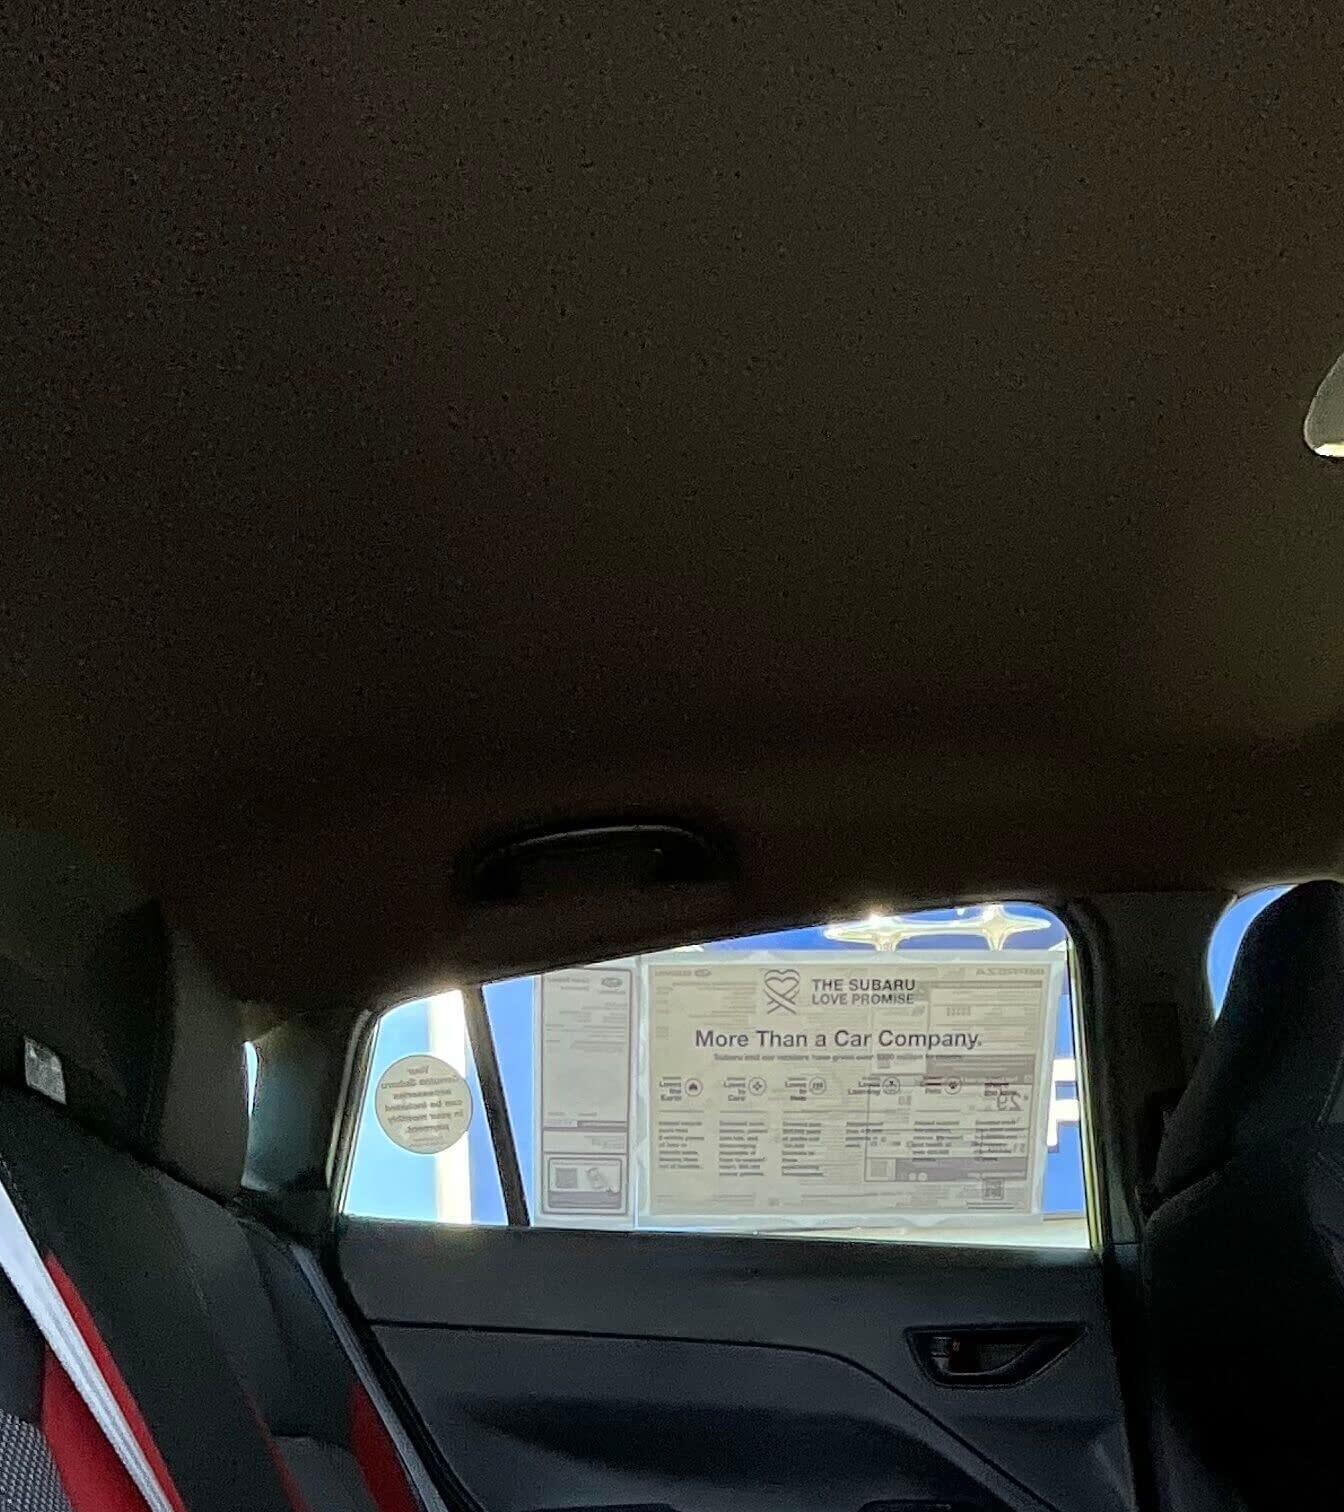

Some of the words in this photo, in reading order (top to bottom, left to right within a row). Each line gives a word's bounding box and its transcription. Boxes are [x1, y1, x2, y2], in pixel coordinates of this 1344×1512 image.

[811, 978, 844, 992] THE
[849, 978, 916, 992] SUBARU
[811, 993, 848, 1005] LOVE
[851, 993, 915, 1005] PROMISE
[695, 1029, 749, 1048] More
[756, 1029, 808, 1048] Than
[814, 1033, 827, 1048] a
[834, 1029, 873, 1048] Car
[878, 1029, 983, 1051] Company.
